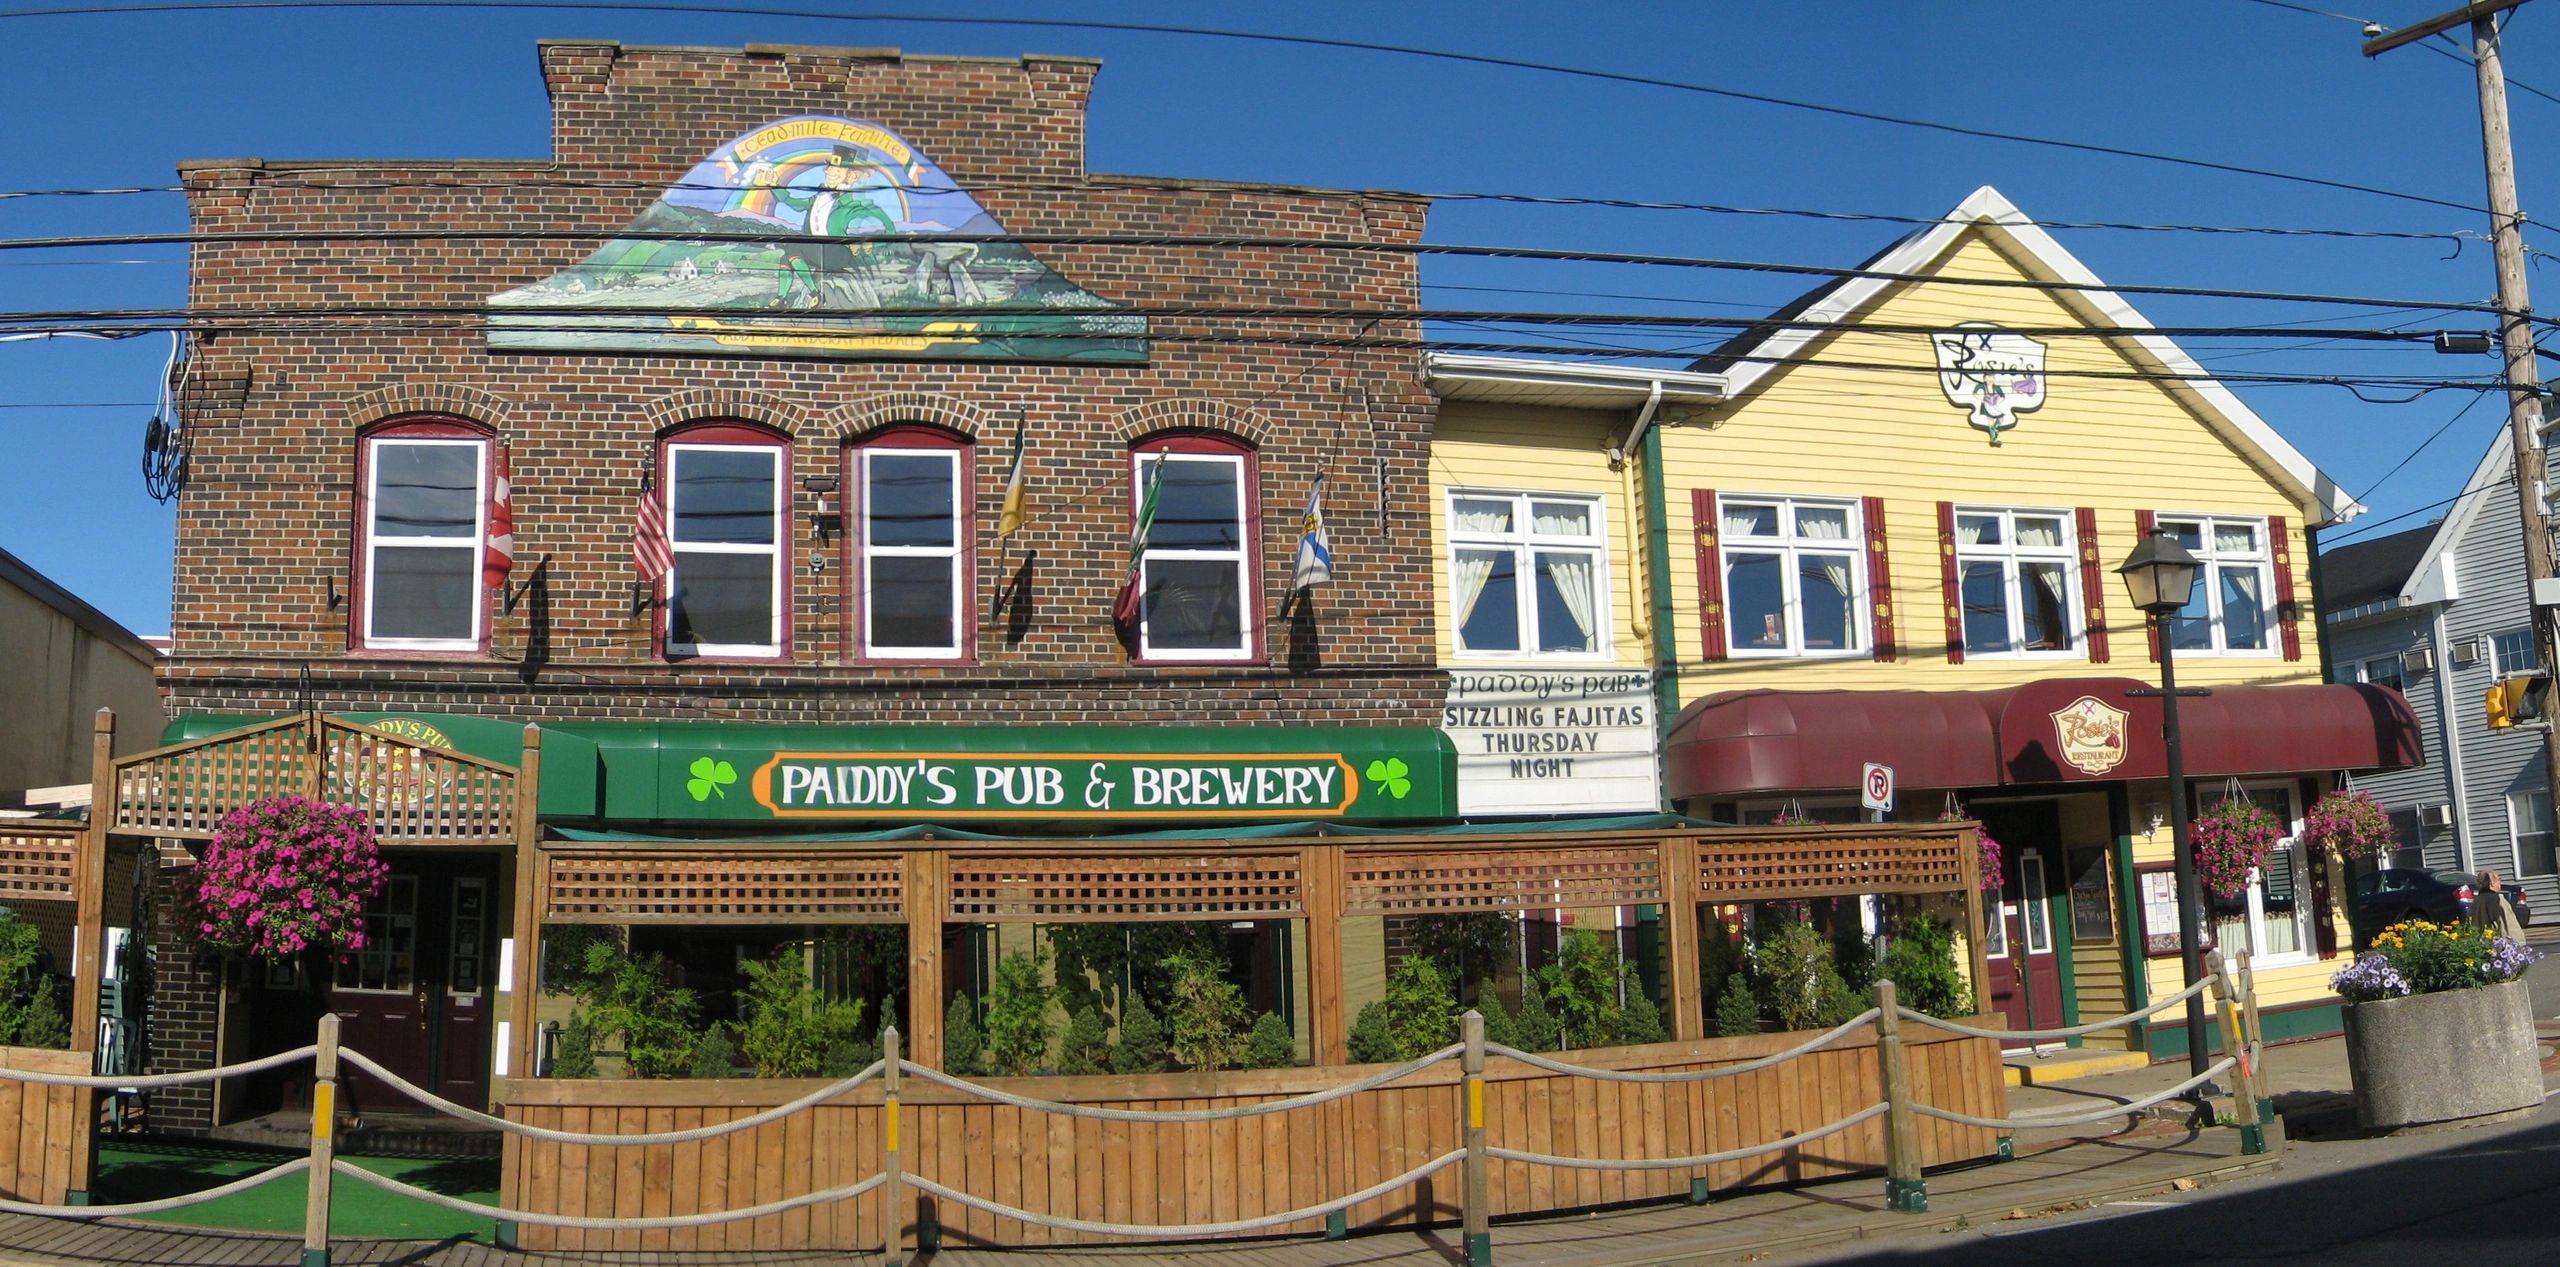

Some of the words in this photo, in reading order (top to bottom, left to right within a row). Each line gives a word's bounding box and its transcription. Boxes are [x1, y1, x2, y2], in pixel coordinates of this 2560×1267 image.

[1446, 706, 1544, 727] SIZZLING
[1554, 705, 1644, 726] FAJITAS
[1482, 732, 1599, 753] THURSDAY
[1510, 758, 1575, 778] NIGHT
[974, 766, 1065, 805] PUB
[1084, 762, 1116, 810] &
[1132, 765, 1337, 805] BREWERY
